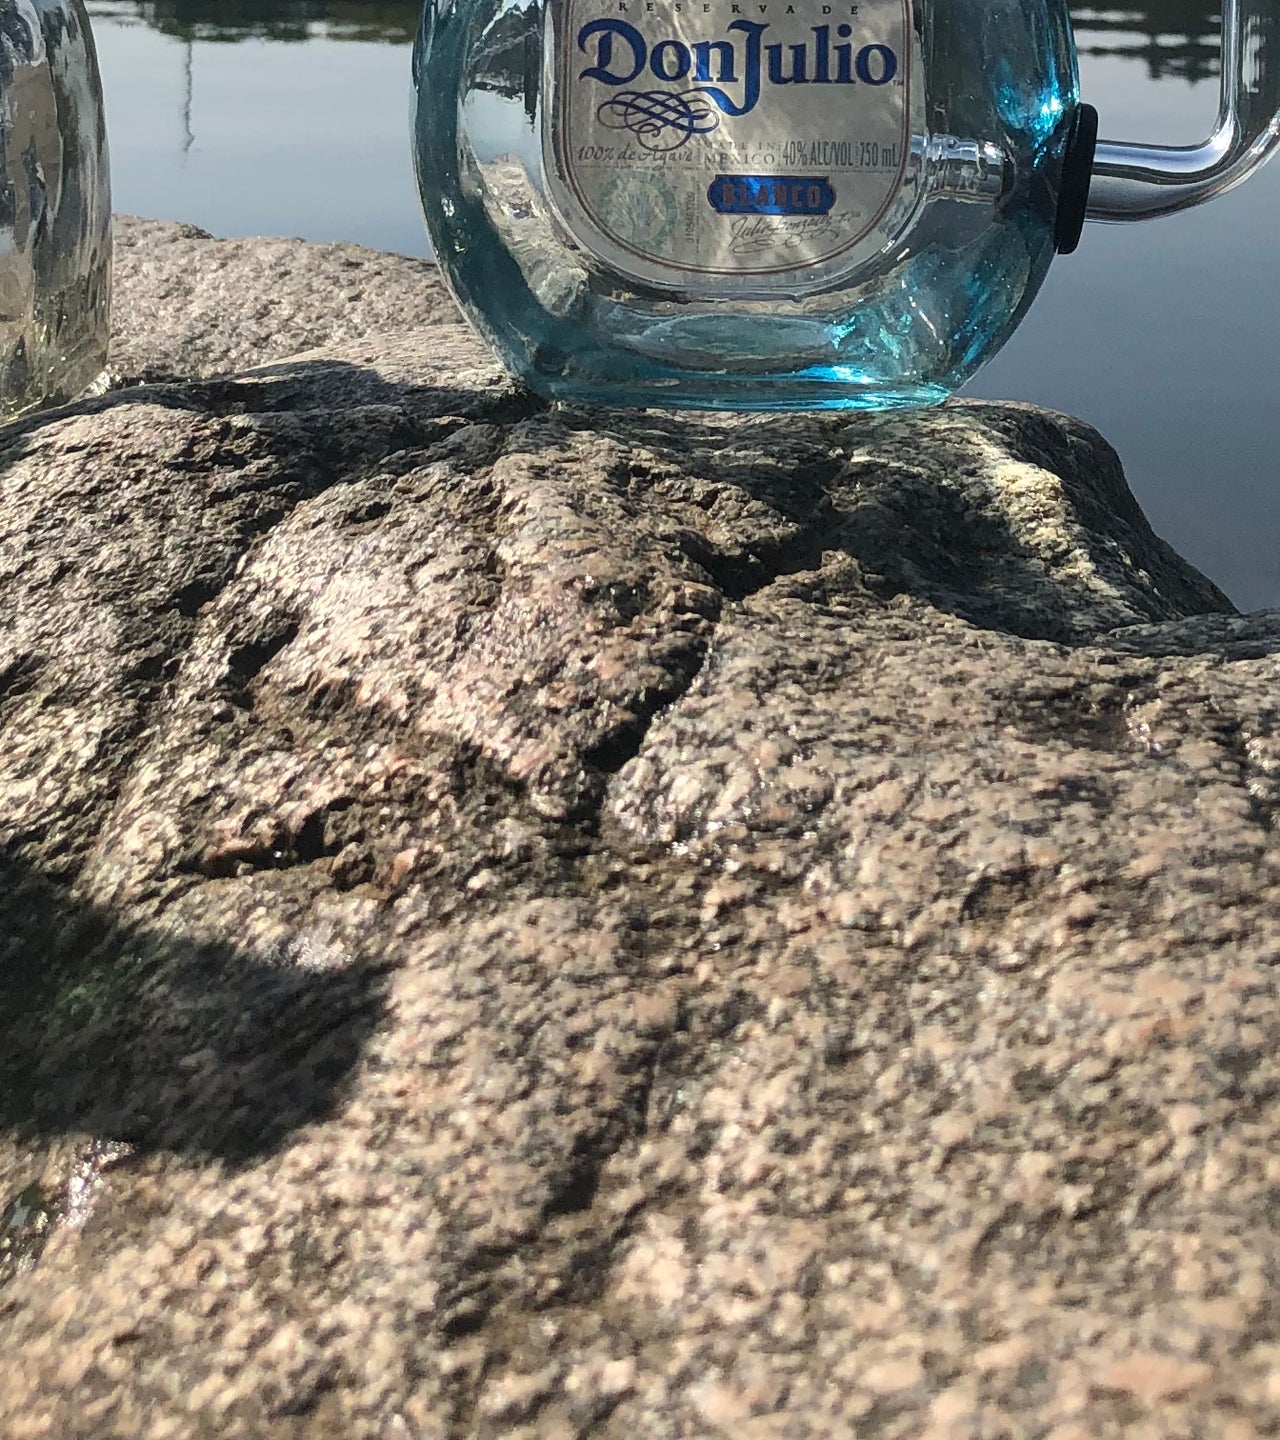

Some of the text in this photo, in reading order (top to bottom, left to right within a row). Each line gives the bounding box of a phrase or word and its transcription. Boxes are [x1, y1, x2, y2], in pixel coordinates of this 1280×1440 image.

[618, 3, 860, 16] RESERVA DE
[577, 145, 616, 162] 100%
[616, 142, 637, 161] de
[704, 151, 776, 166] MEXICO
[782, 140, 808, 166] 40%
[859, 142, 879, 168] 750
[722, 183, 820, 208] BLANCO
